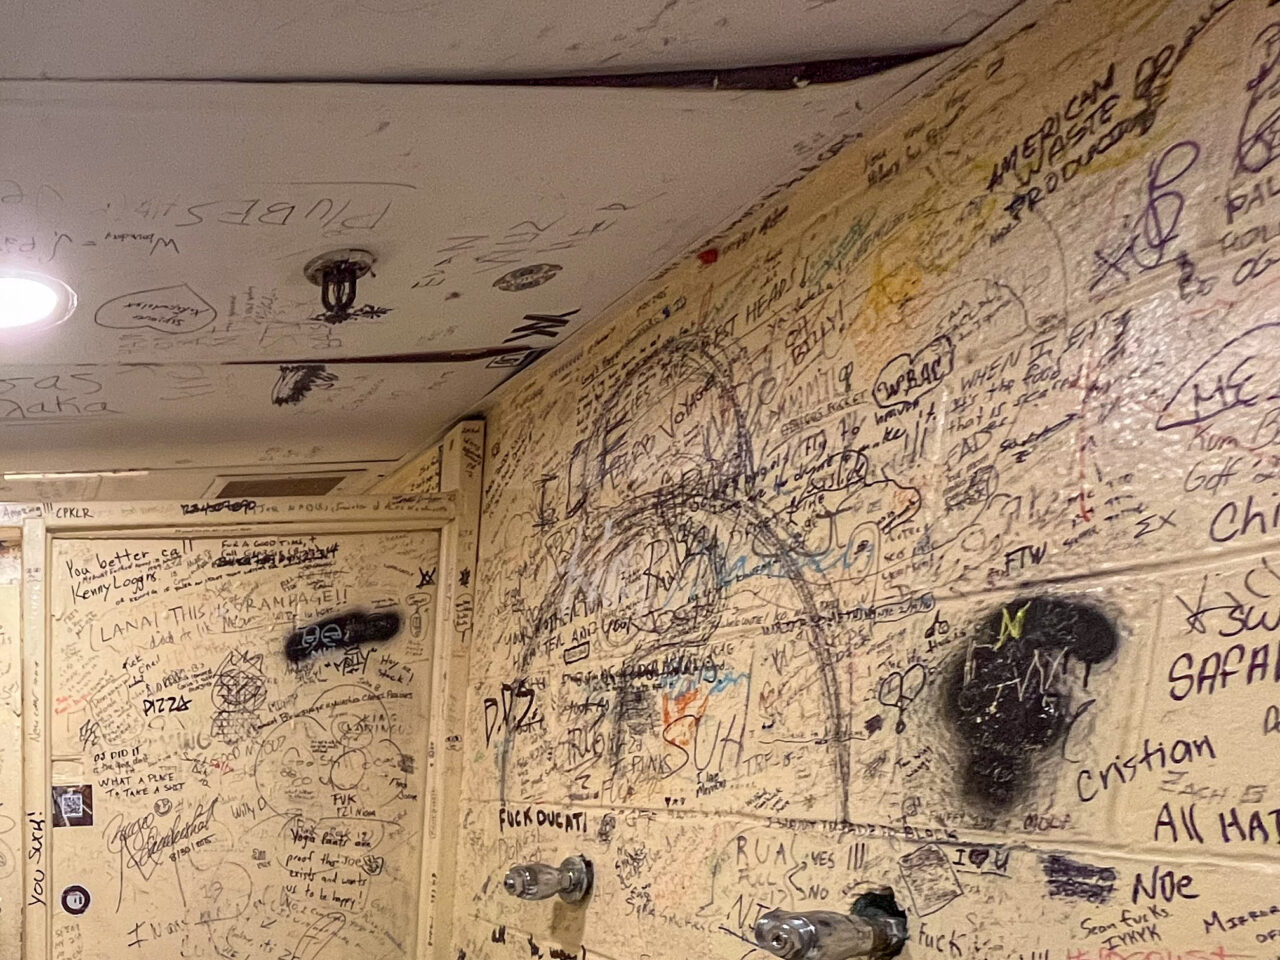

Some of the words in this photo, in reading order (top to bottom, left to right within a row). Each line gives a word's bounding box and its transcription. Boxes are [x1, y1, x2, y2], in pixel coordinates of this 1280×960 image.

[96, 549, 150, 570] better
[110, 748, 129, 760] DID
[1077, 735, 1217, 803] Cristian
[98, 776, 131, 788] WHAT
[138, 777, 146, 785] A
[123, 785, 150, 797] TAKE
[154, 784, 160, 794] A
[498, 808, 534, 834] FUCK
[536, 808, 588, 834] DUCATI
[810, 850, 836, 869] YES
